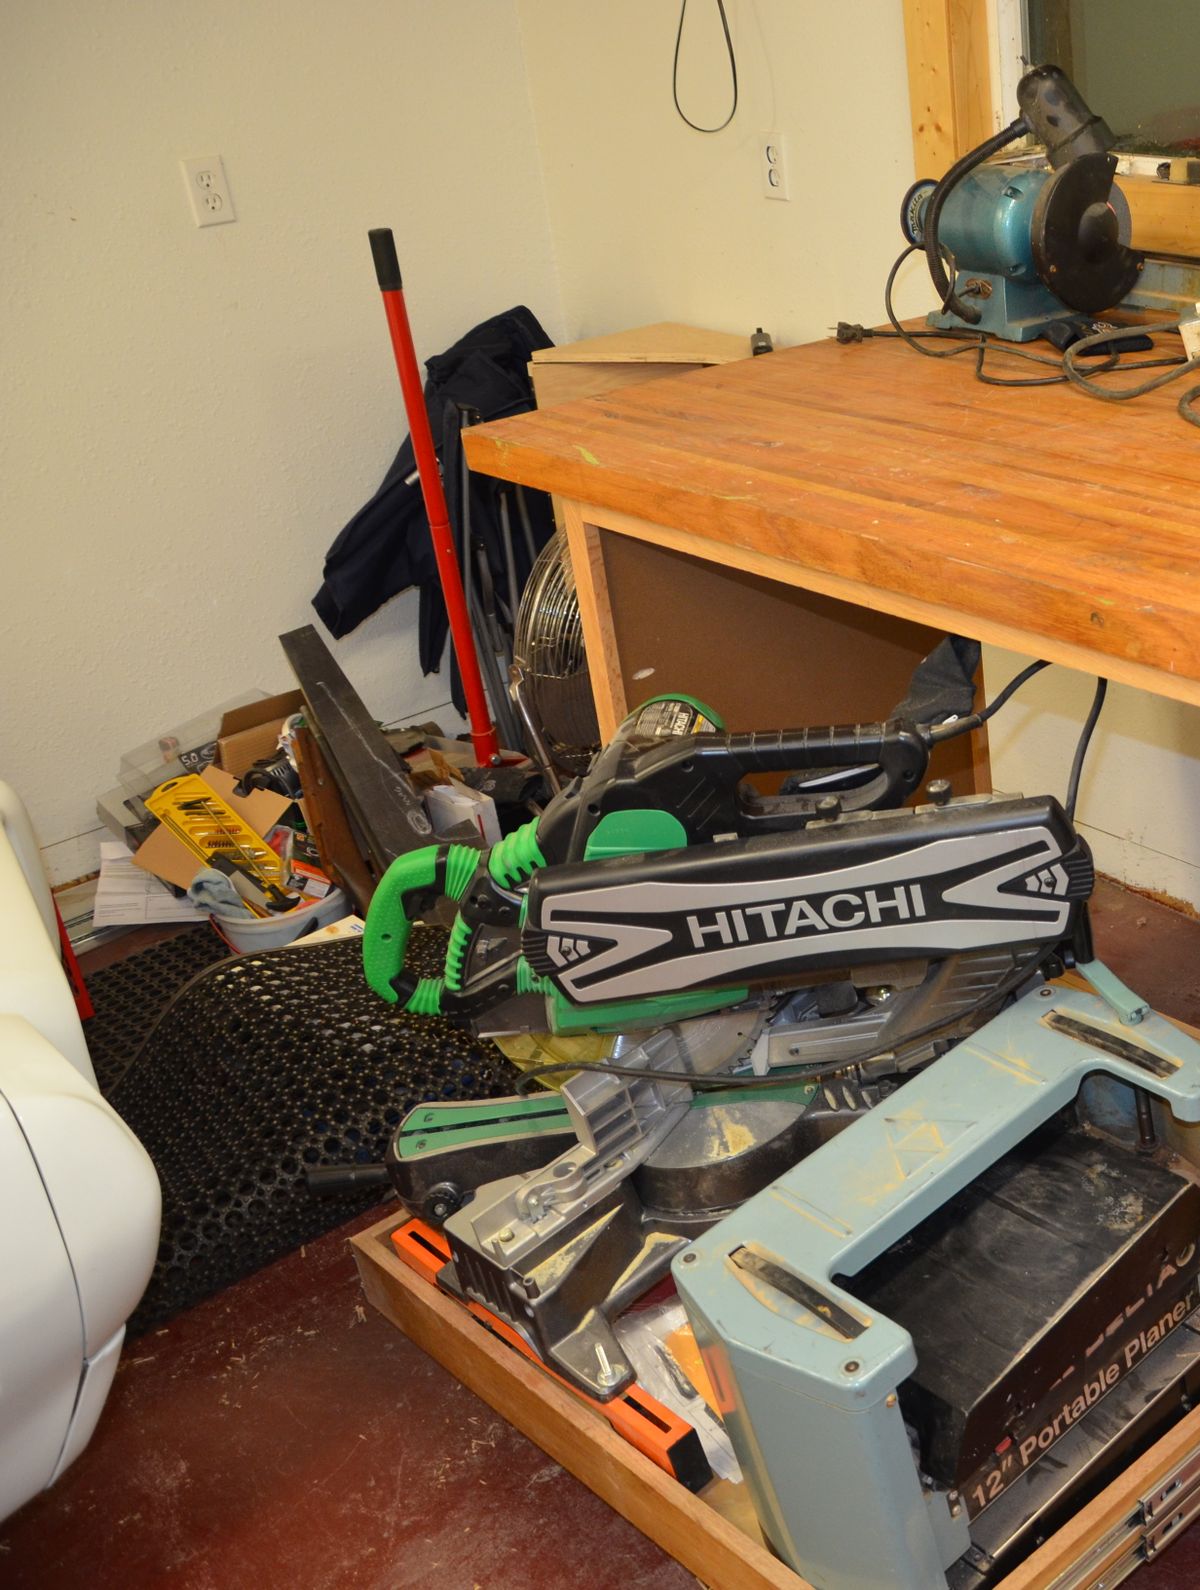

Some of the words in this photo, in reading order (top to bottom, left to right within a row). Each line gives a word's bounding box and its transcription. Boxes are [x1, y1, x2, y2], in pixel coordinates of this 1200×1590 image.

[671, 712, 690, 736] HITACHI
[686, 884, 927, 949] HITACHI
[1019, 1362, 1120, 1467] Portable
[1124, 1290, 1194, 1368] Planer
